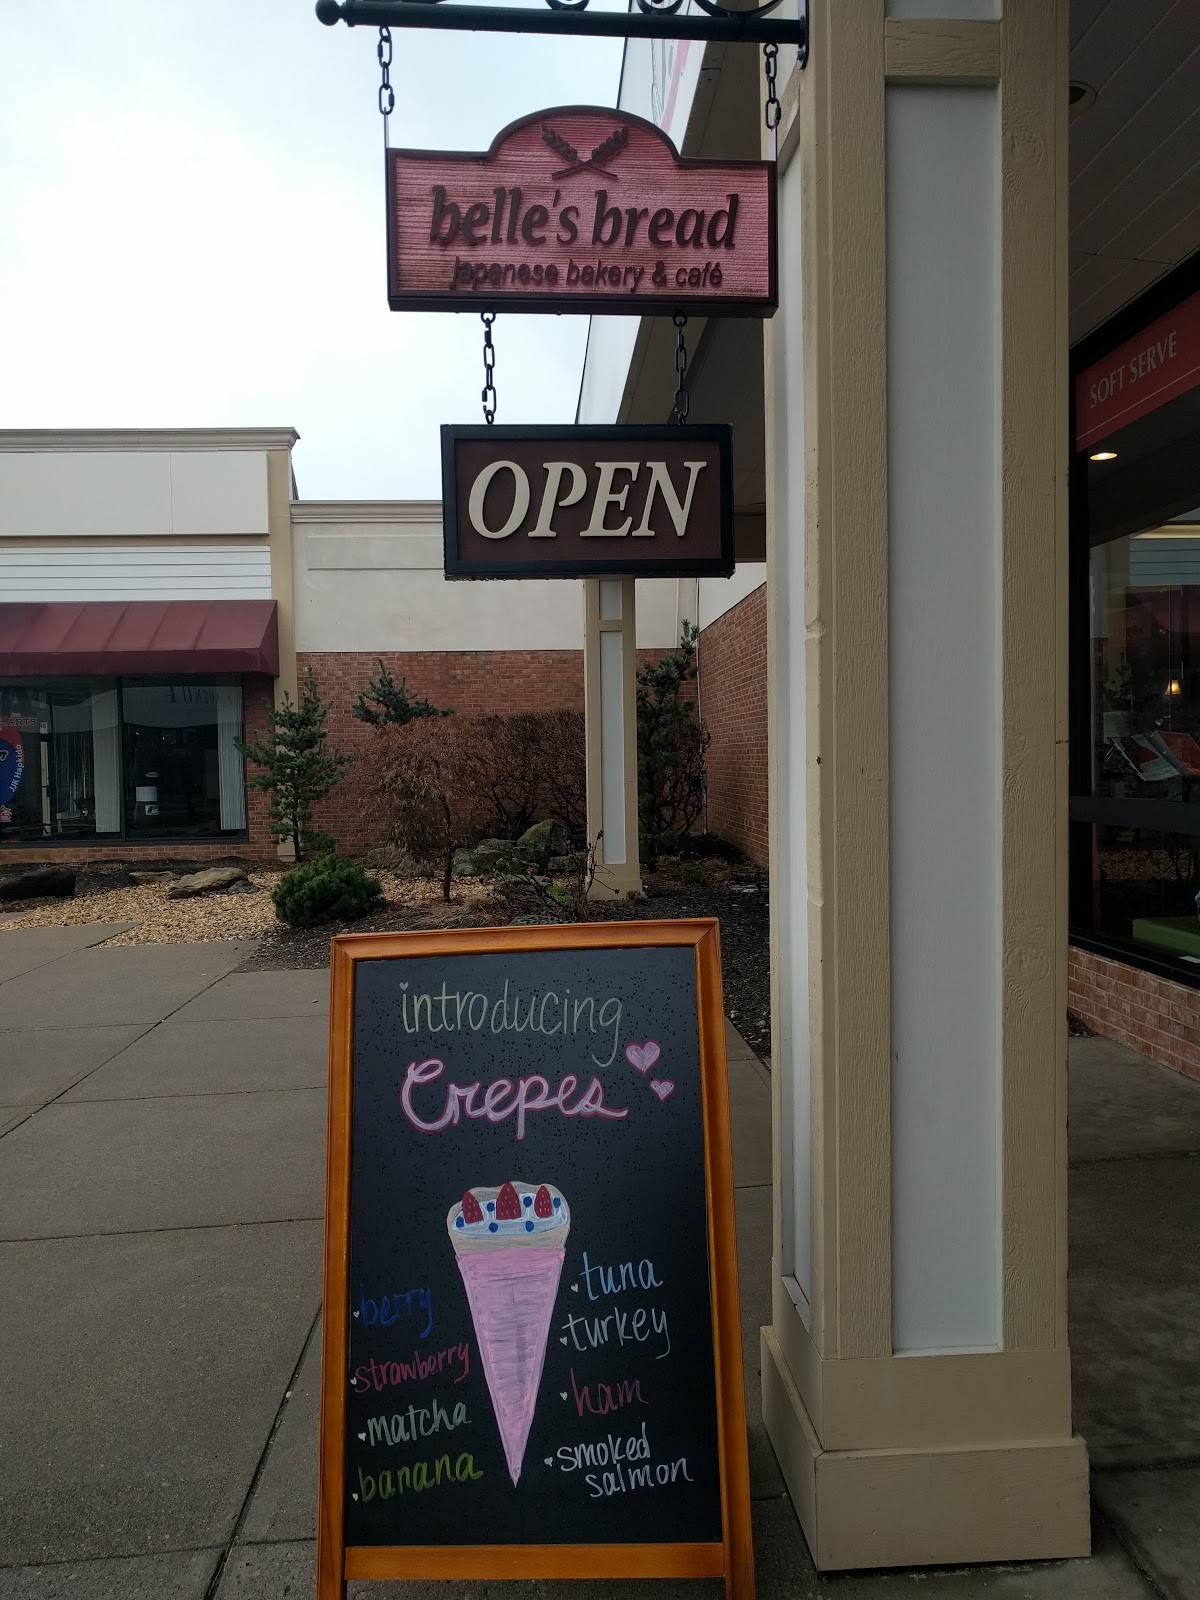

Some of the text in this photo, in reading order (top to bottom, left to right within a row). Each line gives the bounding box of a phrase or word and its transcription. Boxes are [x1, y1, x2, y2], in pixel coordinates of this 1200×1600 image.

[429, 186, 739, 249] belle's bread
[566, 259, 644, 293] bakery
[651, 260, 667, 287] &
[675, 262, 723, 287] café
[1089, 330, 1177, 408] SOFT SERVE
[468, 460, 708, 540] OPEN
[14, 744, 25, 778] Hapkido
[399, 978, 623, 1068] introducing
[400, 1058, 629, 1141] Crepes
[580, 1251, 663, 1300] tuna
[360, 1280, 433, 1340] berry
[562, 1307, 671, 1360] turkey
[570, 1367, 649, 1417] ham
[357, 1452, 484, 1502] banana
[584, 1457, 694, 1498] salmon
